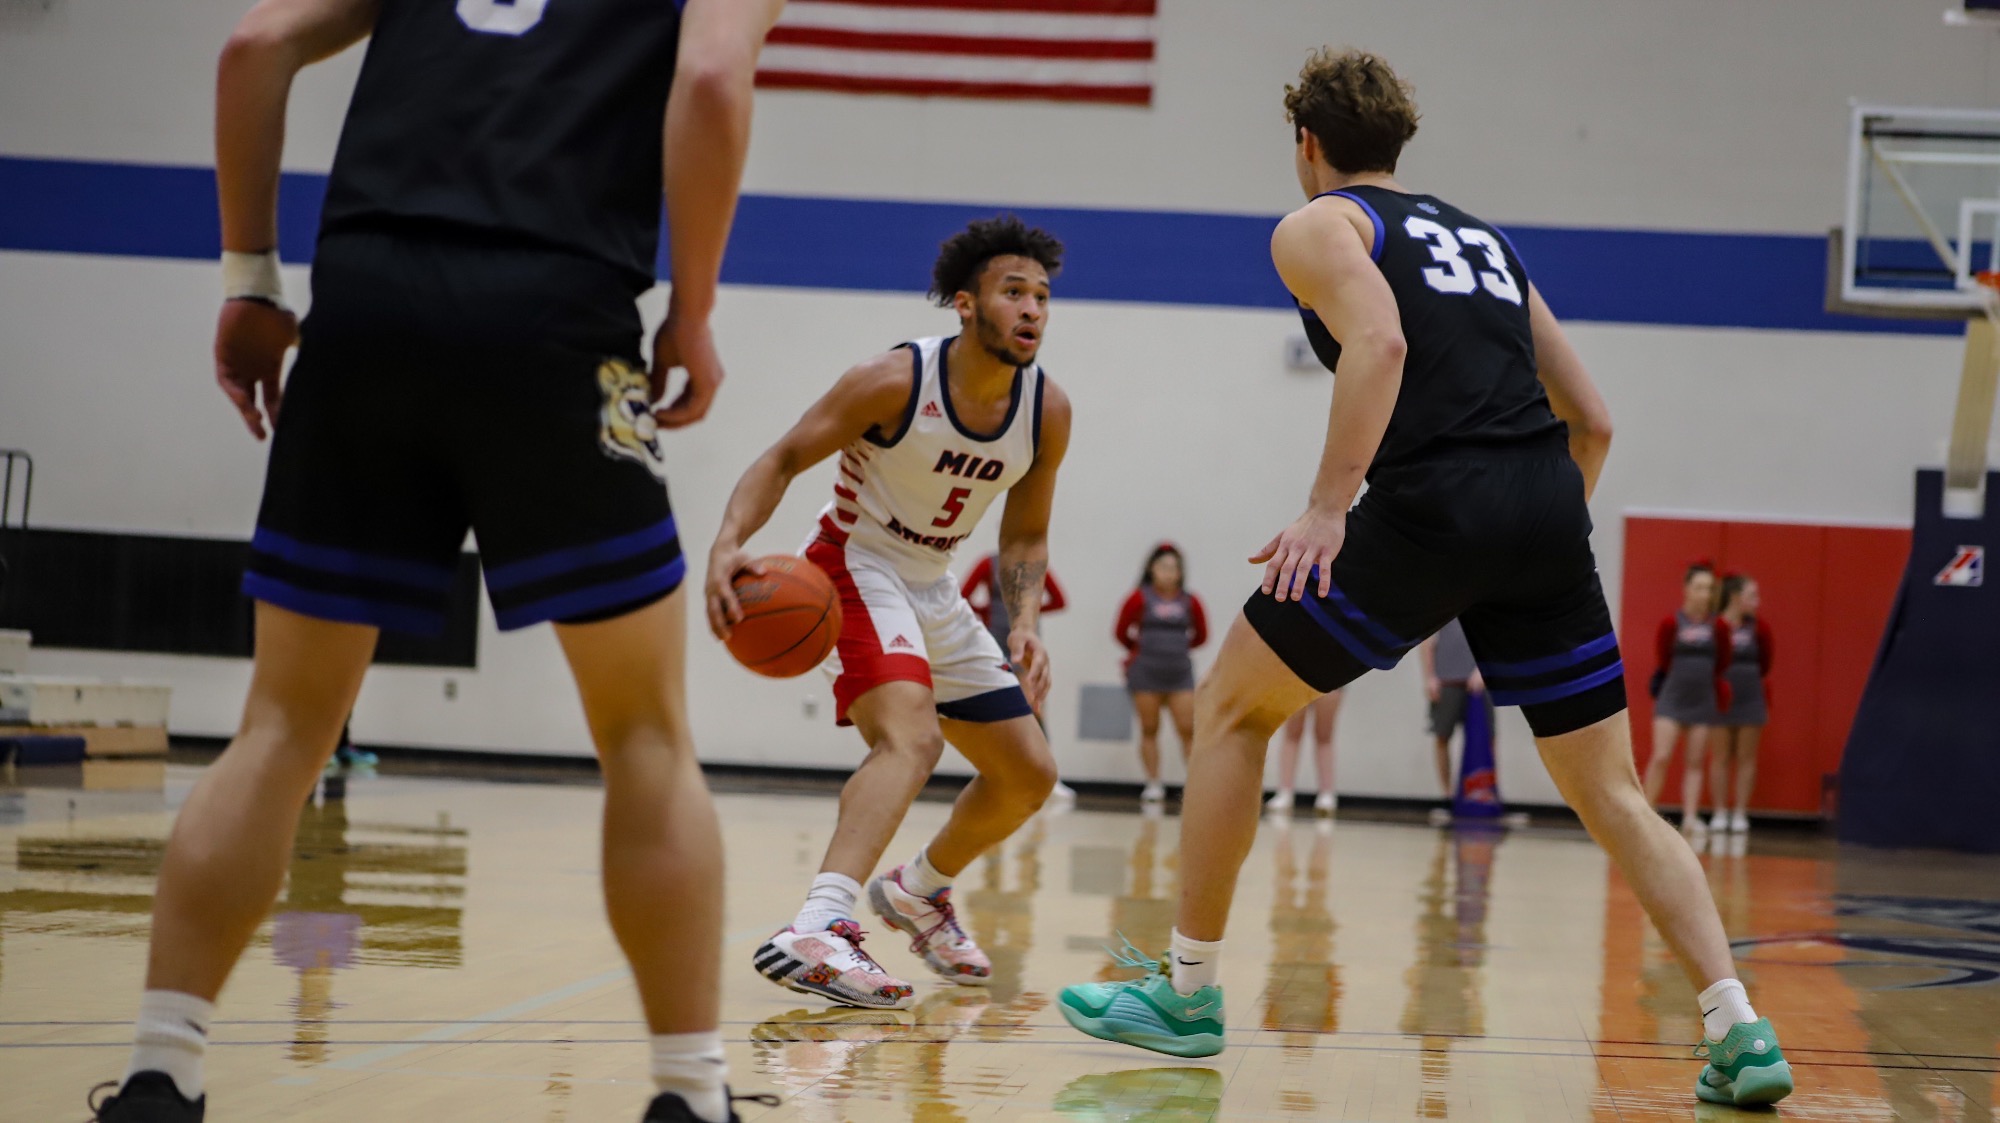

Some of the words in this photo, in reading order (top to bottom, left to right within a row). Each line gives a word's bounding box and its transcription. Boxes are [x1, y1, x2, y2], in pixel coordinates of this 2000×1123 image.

[1402, 215, 1523, 307] 33
[932, 449, 1005, 482] MID
[931, 486, 972, 529] 5
[886, 514, 972, 552] AMERI
